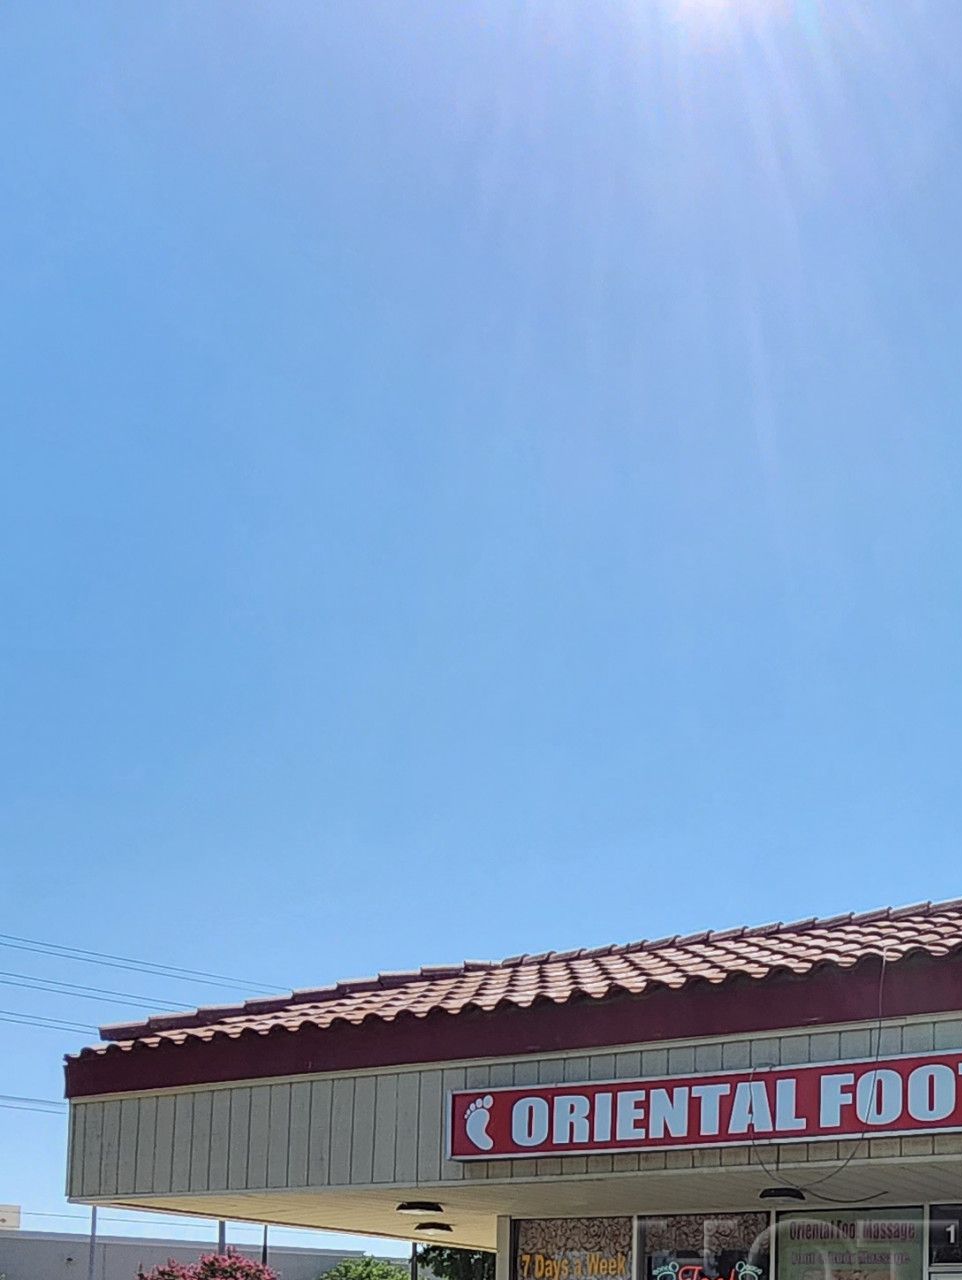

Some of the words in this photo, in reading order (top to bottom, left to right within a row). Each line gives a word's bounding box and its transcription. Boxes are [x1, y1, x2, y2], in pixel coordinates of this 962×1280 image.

[512, 1078, 806, 1147] ORIENTAL
[863, 1219, 915, 1241] Massage
[521, 1254, 531, 1277] 7
[587, 1251, 626, 1276] Week
